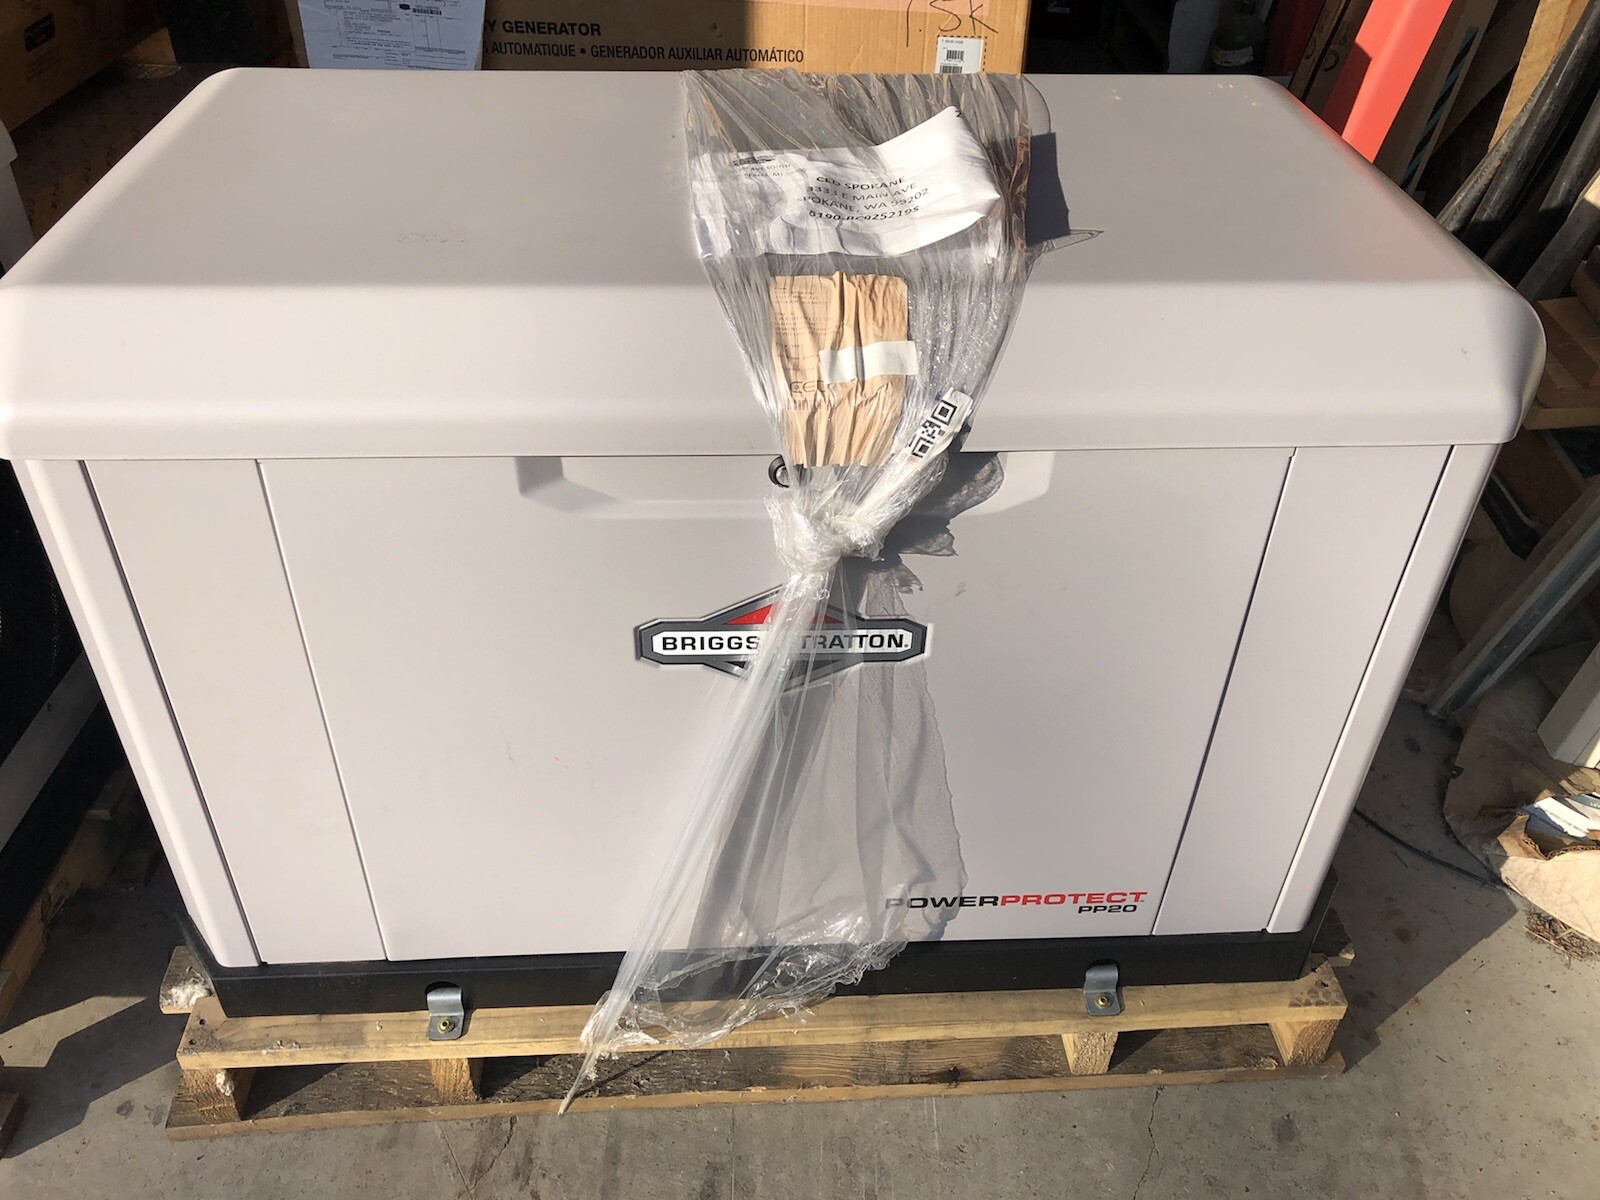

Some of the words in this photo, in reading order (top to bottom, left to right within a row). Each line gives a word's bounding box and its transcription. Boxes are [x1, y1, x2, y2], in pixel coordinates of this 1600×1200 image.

[502, 20, 601, 36] GENERATOR
[492, 42, 576, 57] AUTOMATIQUE
[591, 45, 664, 60] GENERADOR
[668, 47, 723, 61] AUXILIAR
[725, 47, 804, 63] AUTOMÁTICO
[844, 176, 906, 190] SPOKANE
[797, 196, 860, 213] POKANE,
[864, 202, 887, 211] WA
[852, 192, 888, 202] MAIN
[662, 636, 759, 650] BRIGGS
[800, 633, 904, 649] TRATTON
[1078, 904, 1137, 914] PP20
